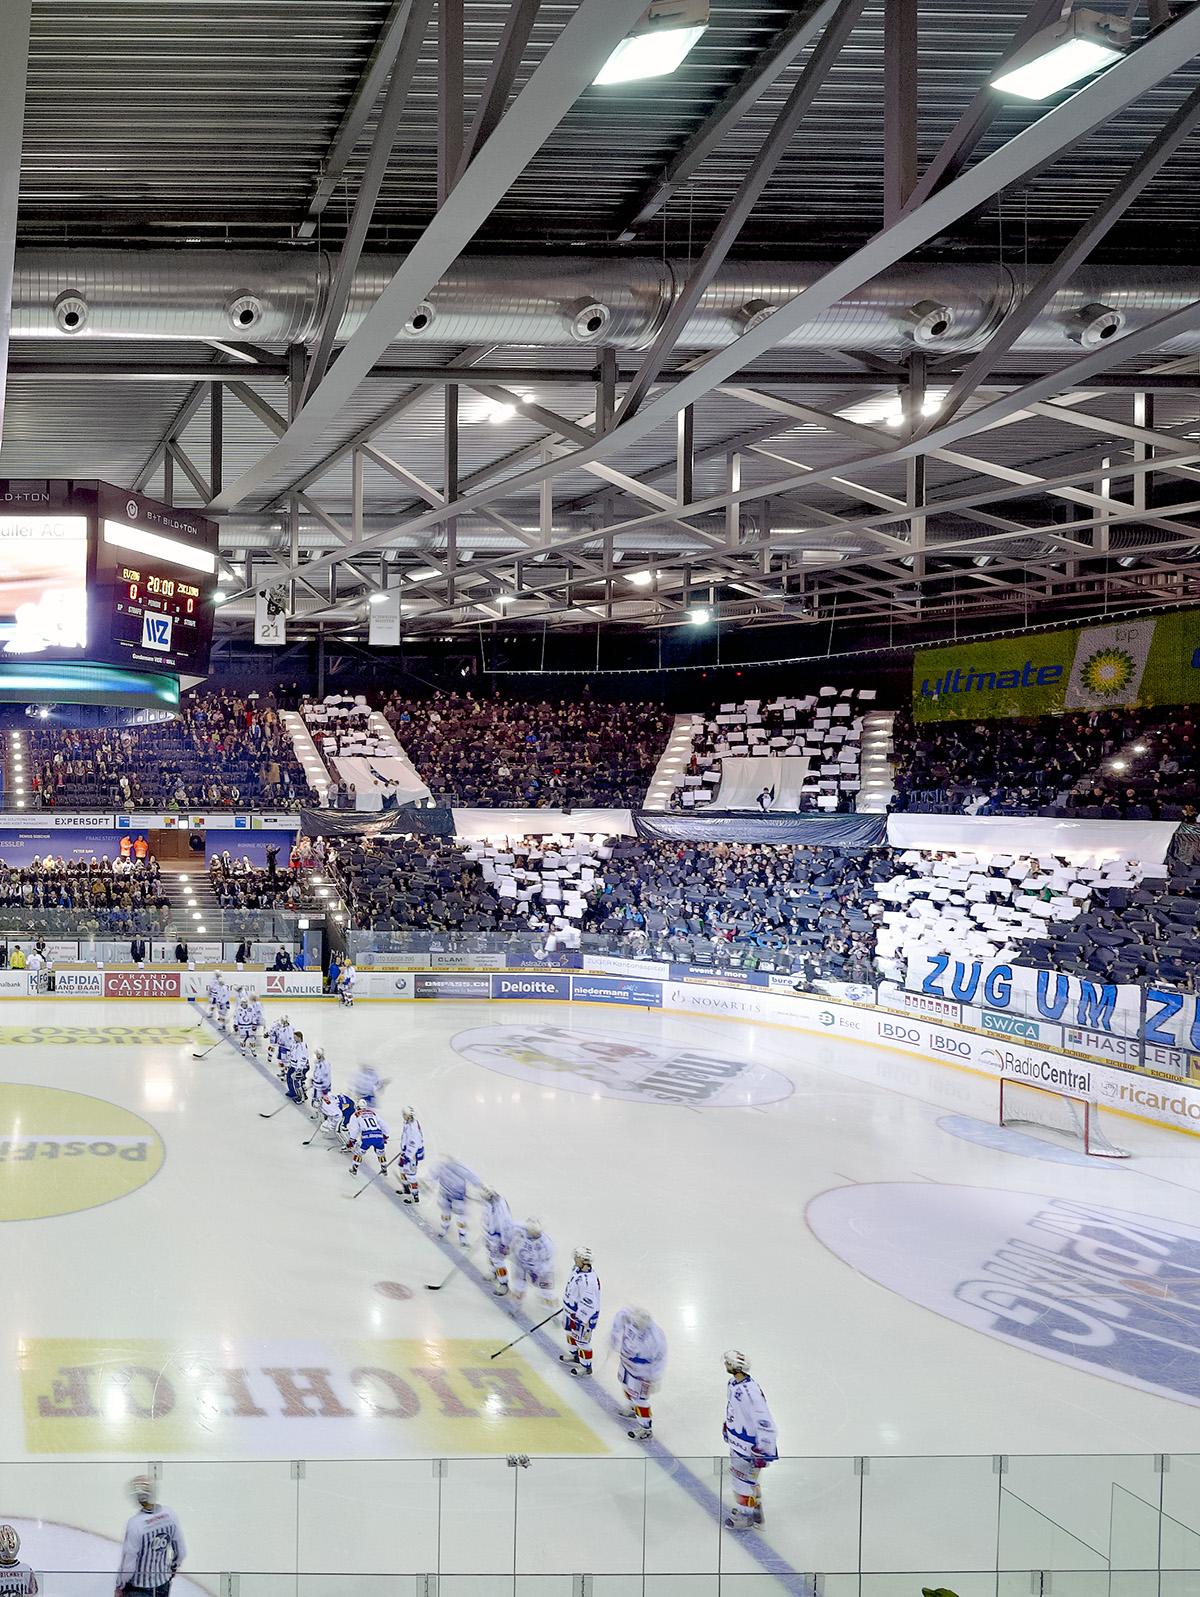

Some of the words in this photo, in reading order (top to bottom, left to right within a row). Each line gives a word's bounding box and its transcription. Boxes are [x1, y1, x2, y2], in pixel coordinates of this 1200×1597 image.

[130, 584, 137, 600] 0
[147, 576, 174, 597] 20:00
[187, 598, 193, 613] 0
[261, 624, 280, 638] 21
[921, 660, 1064, 697] ultimate
[689, 966, 717, 976] event
[723, 971, 748, 979] more
[59, 976, 99, 985] AFIDIA
[108, 980, 177, 991] CASINO
[501, 981, 559, 994] Deloitte.
[574, 987, 629, 997] niedermann
[921, 955, 1014, 1009] ZUG
[1037, 969, 1118, 1032] UM
[692, 997, 761, 1013] NOVARTIS
[839, 1018, 861, 1030] Esec
[884, 1023, 921, 1042] BDO
[935, 1036, 971, 1056] BDO
[1087, 1034, 1181, 1067] HASSLER
[1063, 1048, 1092, 1060] EICHHOF
[1105, 1058, 1136, 1071] EICHHOF
[1005, 1052, 1091, 1092] RadioCentral
[1151, 1069, 1184, 1081] EICHHOF
[364, 1118, 377, 1128] 10
[37, 1366, 561, 1419] EICHHOF
